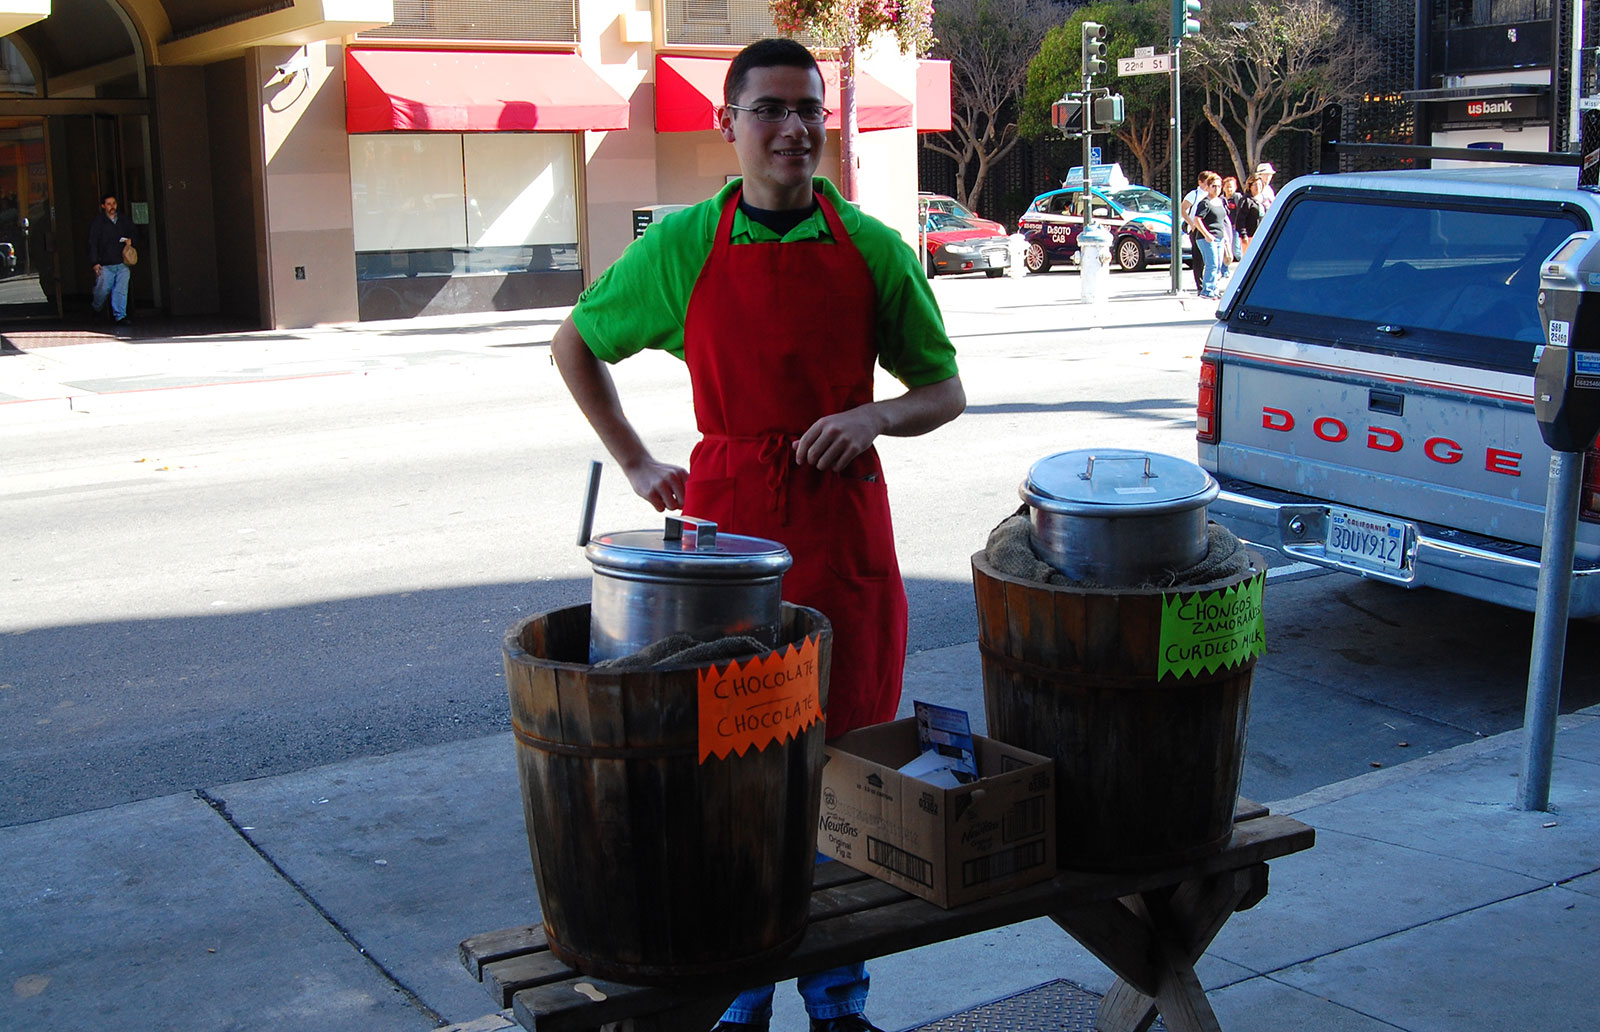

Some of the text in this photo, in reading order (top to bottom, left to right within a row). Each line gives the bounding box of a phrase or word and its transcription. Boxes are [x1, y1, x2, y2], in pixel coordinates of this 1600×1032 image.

[1125, 59, 1163, 72] 22nd St
[1052, 234, 1066, 243] CAB
[1262, 406, 1522, 477] DODGE
[1333, 516, 1345, 524] SEP
[1347, 518, 1386, 532] CALIFORNIA
[1332, 526, 1397, 563] 3DUY912
[1177, 596, 1251, 621] CHONGOS
[1165, 628, 1263, 663] CURDLED MILK
[714, 658, 813, 699] CHOCOLATE
[717, 694, 812, 737] CHOCOLATE
[819, 815, 858, 837] Newtons
[829, 834, 852, 850] Original
